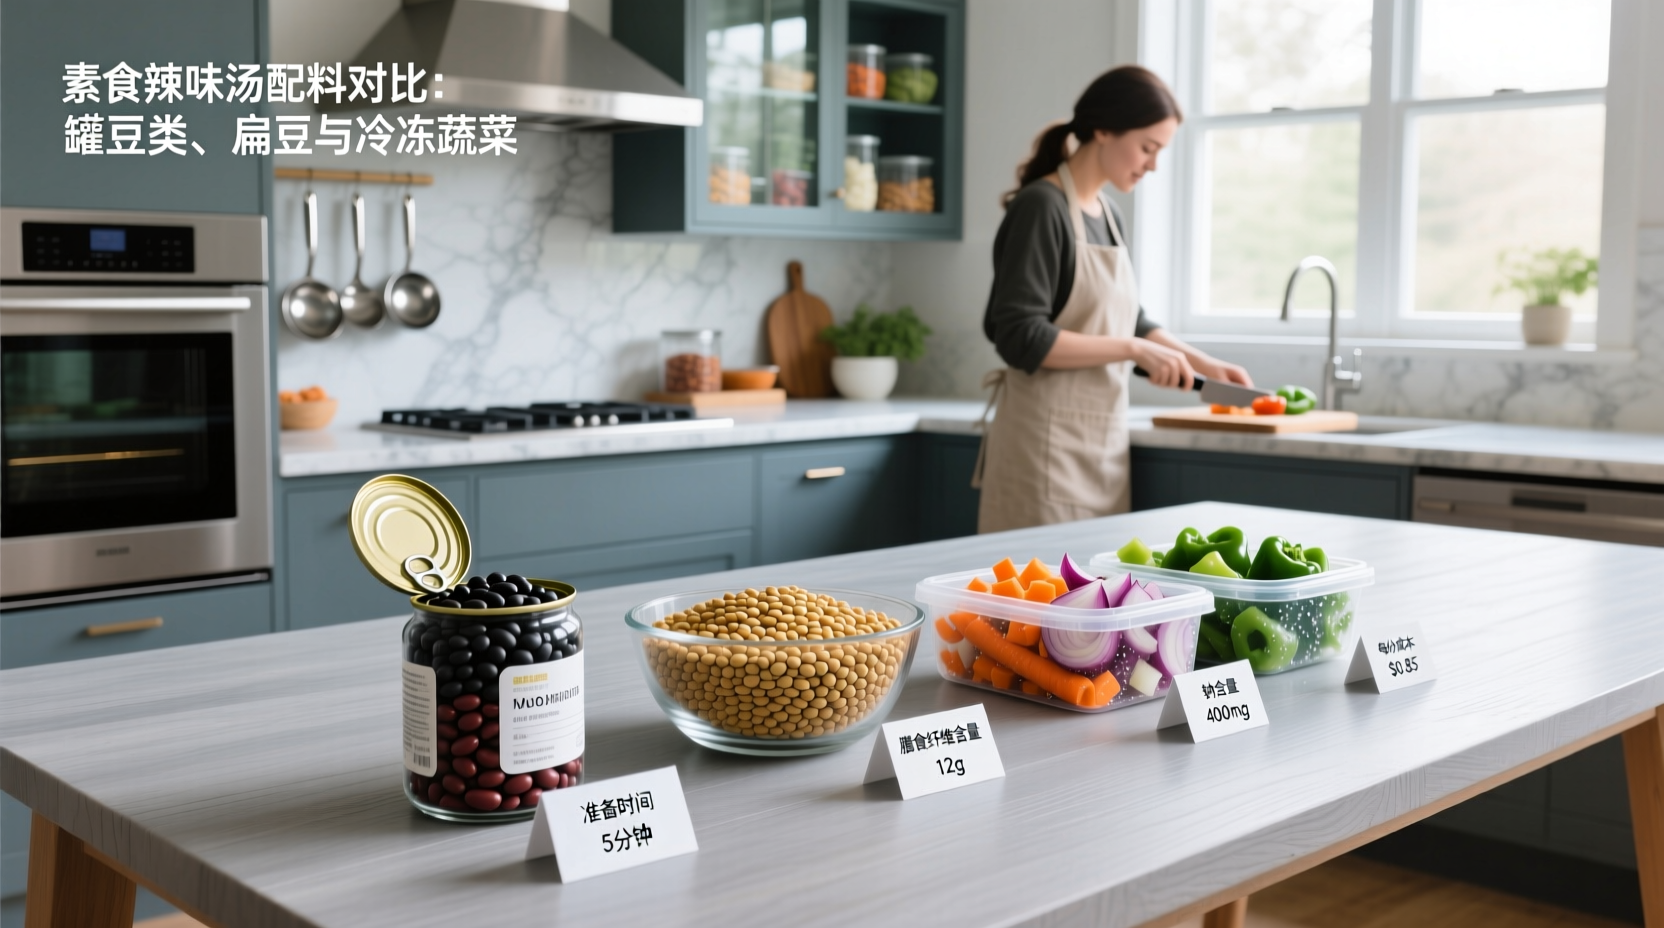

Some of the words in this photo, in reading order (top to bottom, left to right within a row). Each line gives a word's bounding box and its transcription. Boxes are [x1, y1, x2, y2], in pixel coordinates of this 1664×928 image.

[1207, 704, 1251, 723] 400mg
[936, 757, 966, 777] 12g
[580, 790, 655, 824] 准备时间
[602, 823, 653, 853] 5分钟
